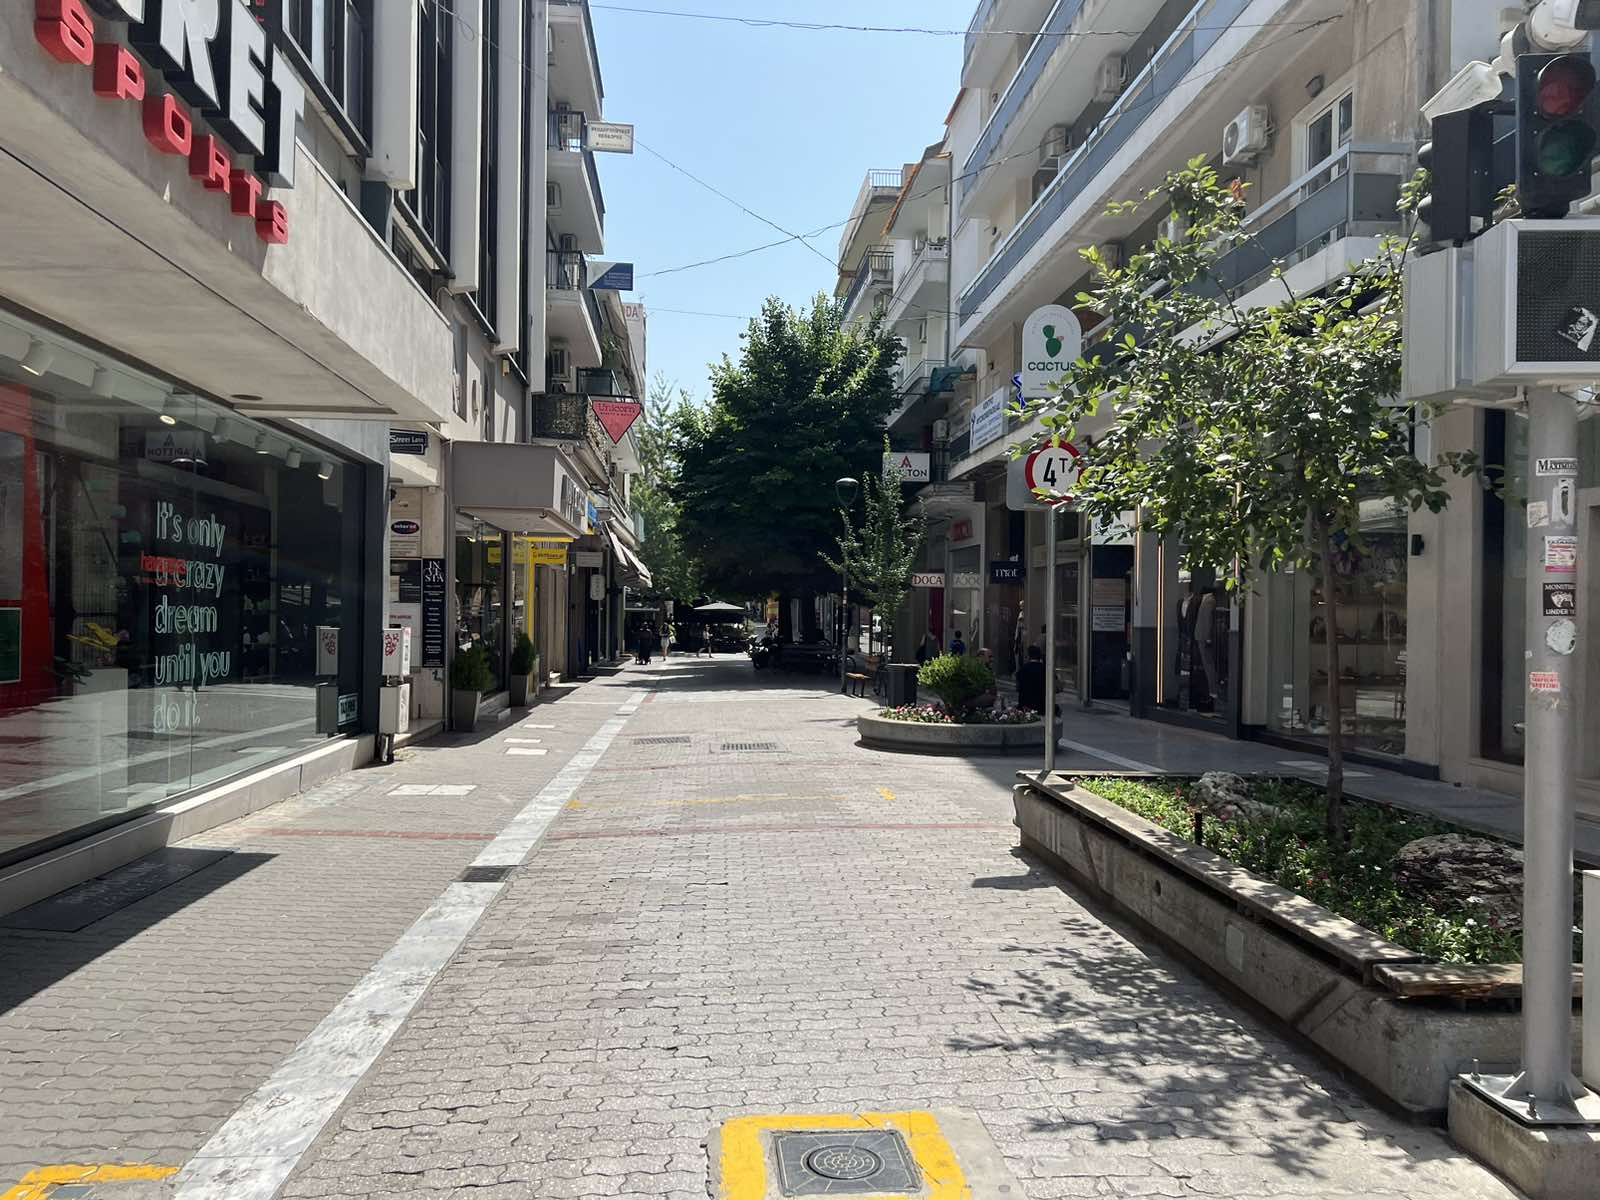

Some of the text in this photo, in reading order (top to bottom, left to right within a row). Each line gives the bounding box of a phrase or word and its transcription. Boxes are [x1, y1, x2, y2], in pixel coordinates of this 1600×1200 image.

[38, 0, 289, 245] SPORTS
[156, 500, 226, 558] It's only
[174, 559, 225, 598] crazy
[155, 594, 218, 634] dream
[155, 644, 231, 687] until you
